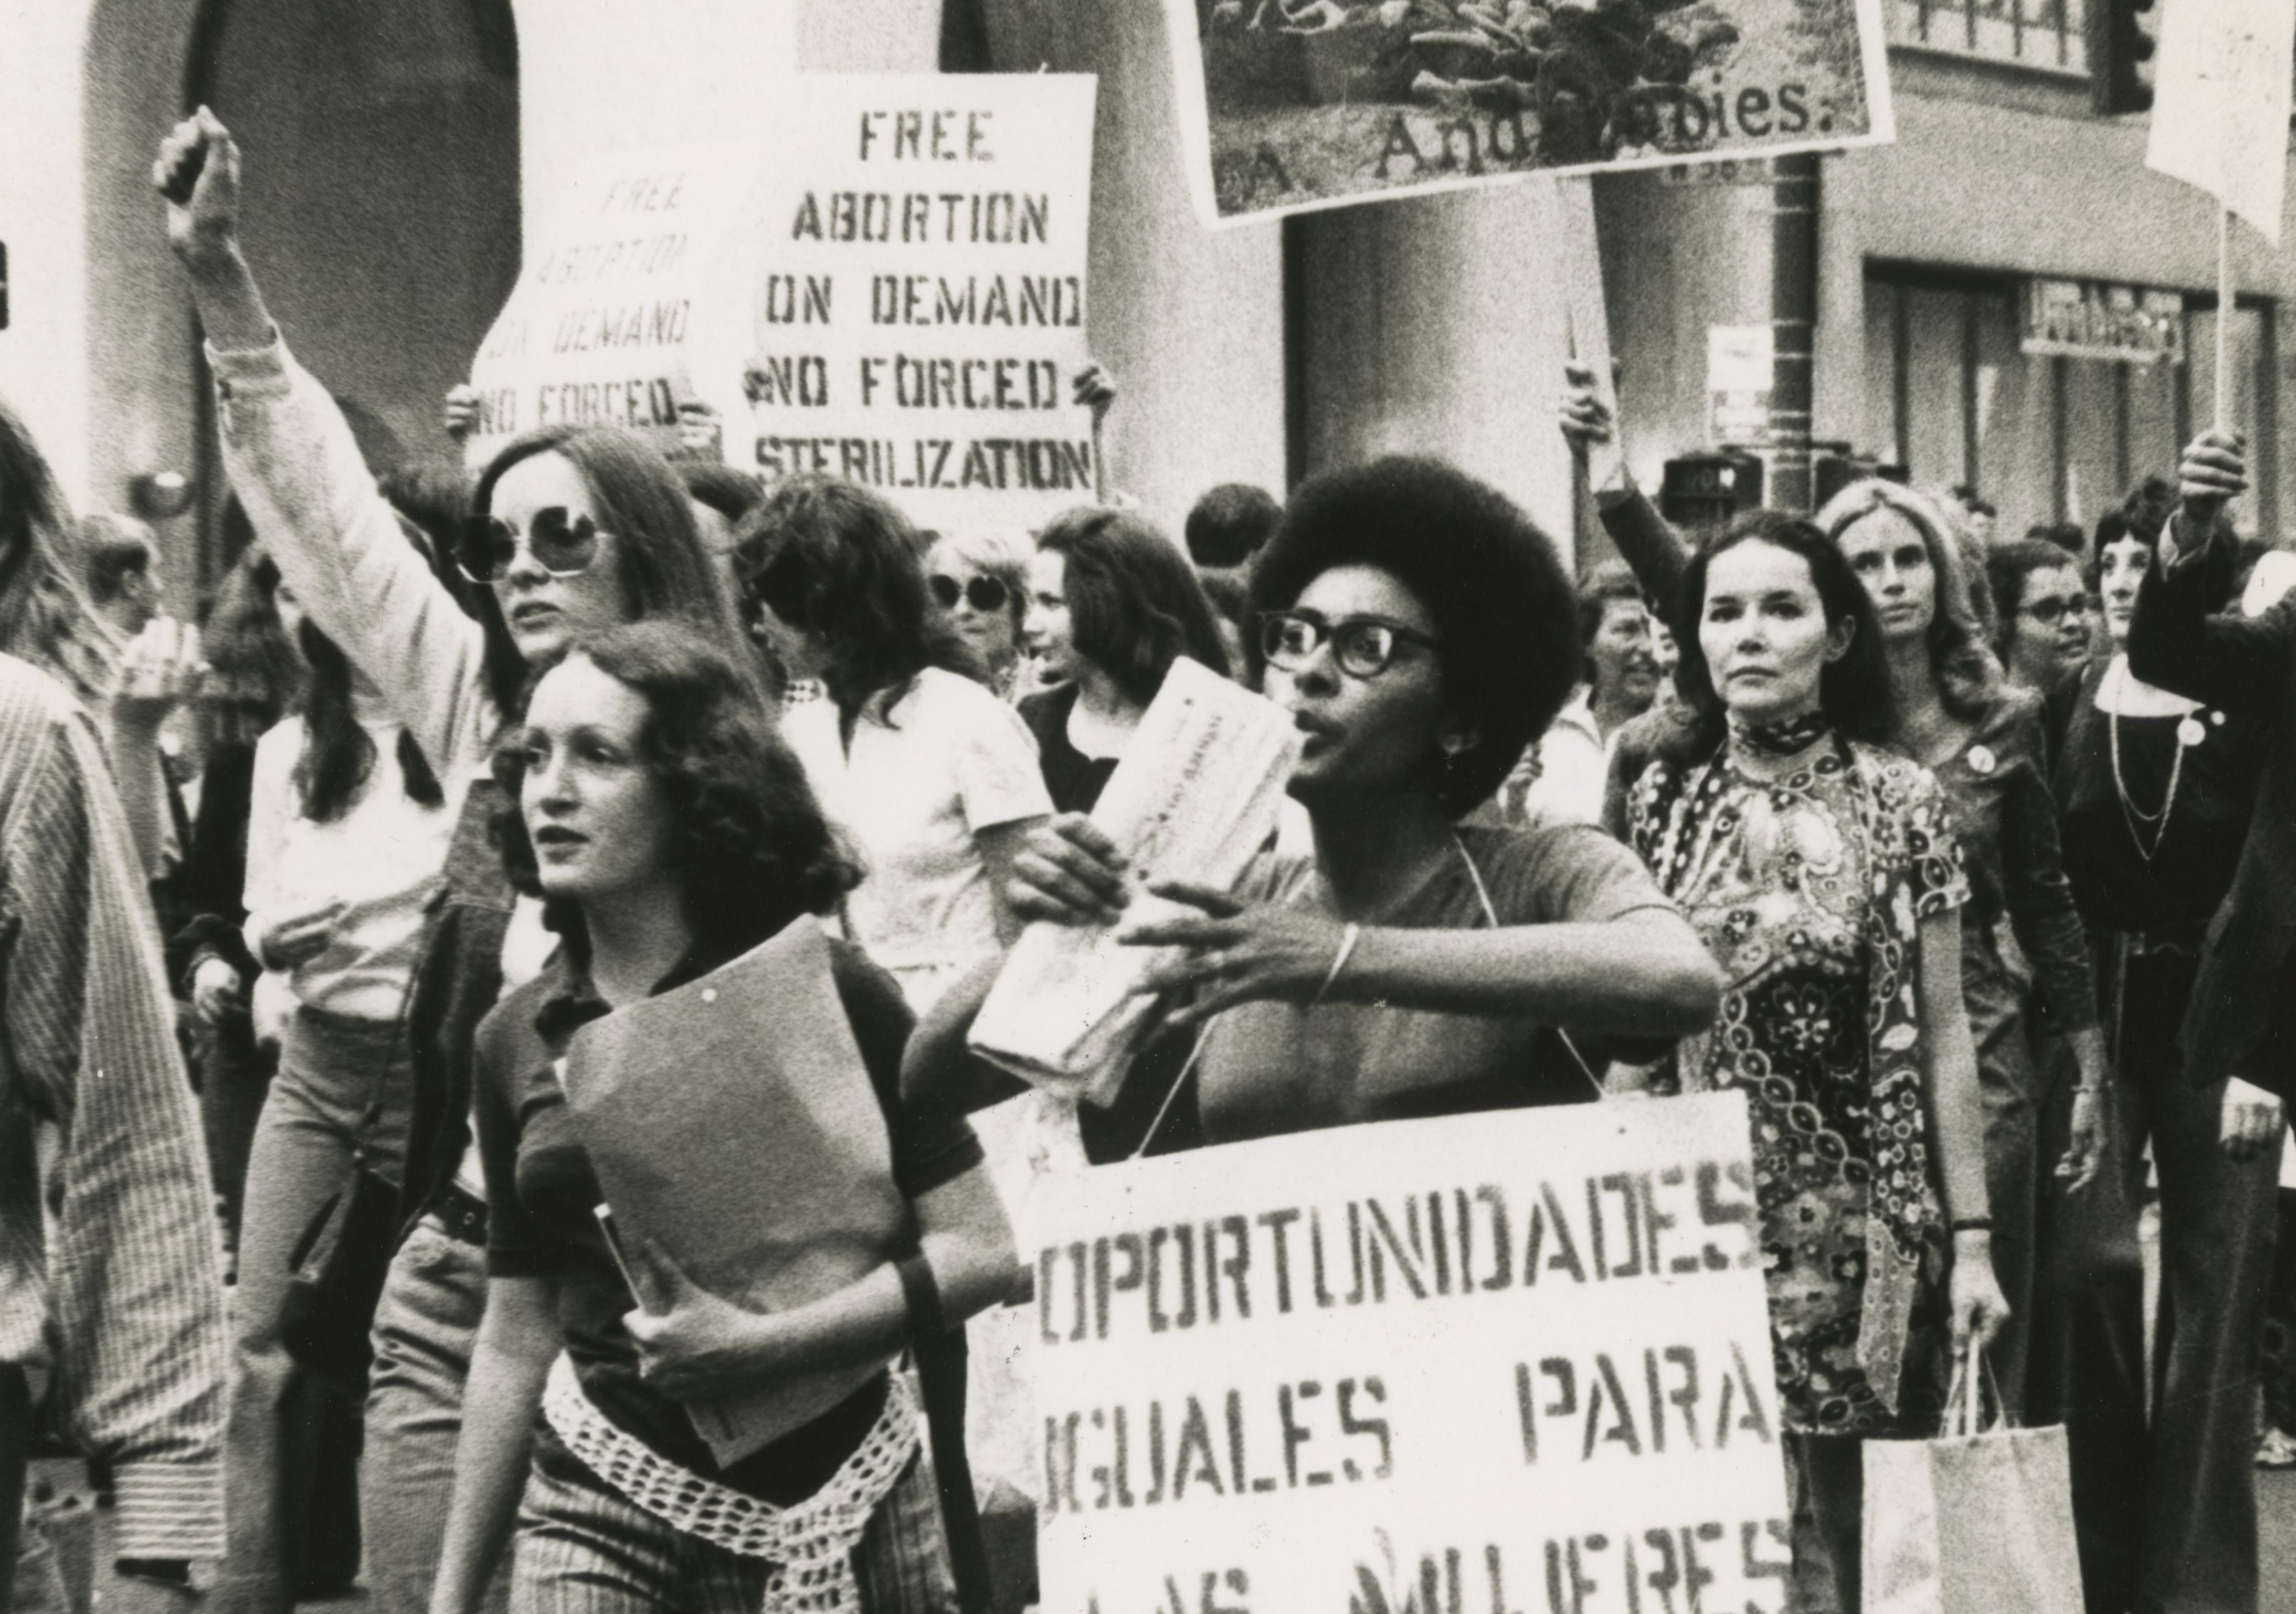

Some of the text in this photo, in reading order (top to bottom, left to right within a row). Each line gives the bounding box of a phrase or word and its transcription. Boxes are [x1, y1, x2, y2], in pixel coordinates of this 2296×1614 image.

[858, 109, 993, 162] FREE
[1373, 102, 1540, 182] And
[1577, 69, 1834, 156] bies.
[598, 171, 687, 216] FREE
[790, 190, 1050, 245] ABORTION
[551, 297, 693, 355] DEMAND
[766, 273, 1081, 328] ON DEMAND
[475, 375, 679, 437] NO FORCED
[765, 352, 1059, 410] NO FORCED
[754, 436, 1093, 490] STERILIZATION
[1039, 1161, 1762, 1345] OPORTUNIDADES
[1043, 1339, 1774, 1514] IGUALES PARA
